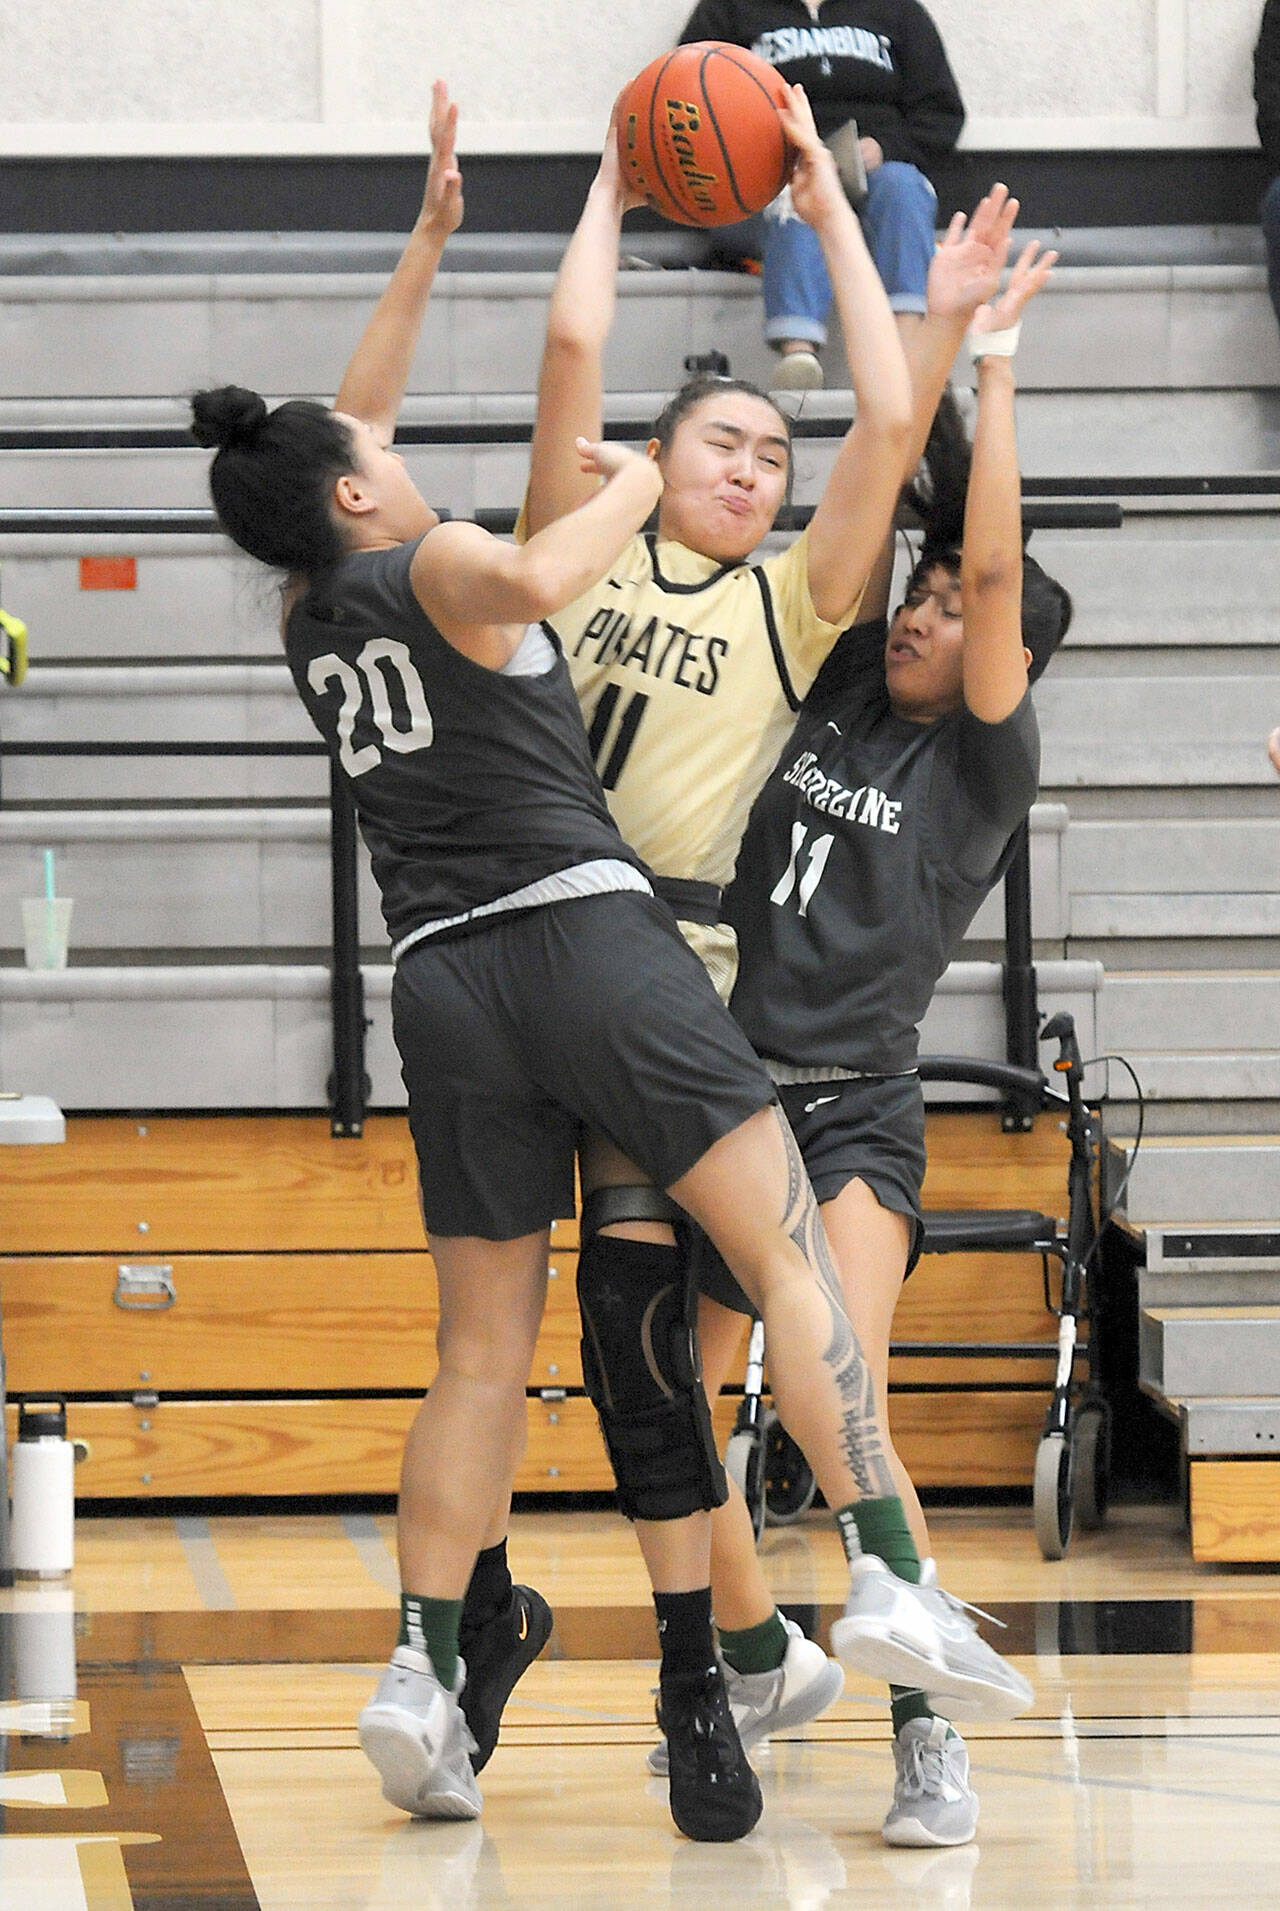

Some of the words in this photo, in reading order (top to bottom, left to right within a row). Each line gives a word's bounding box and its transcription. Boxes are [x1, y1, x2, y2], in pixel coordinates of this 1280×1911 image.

[573, 607, 729, 696] PIRATES
[307, 637, 434, 778] 20
[588, 682, 650, 791] 11
[769, 821, 835, 918] 11
